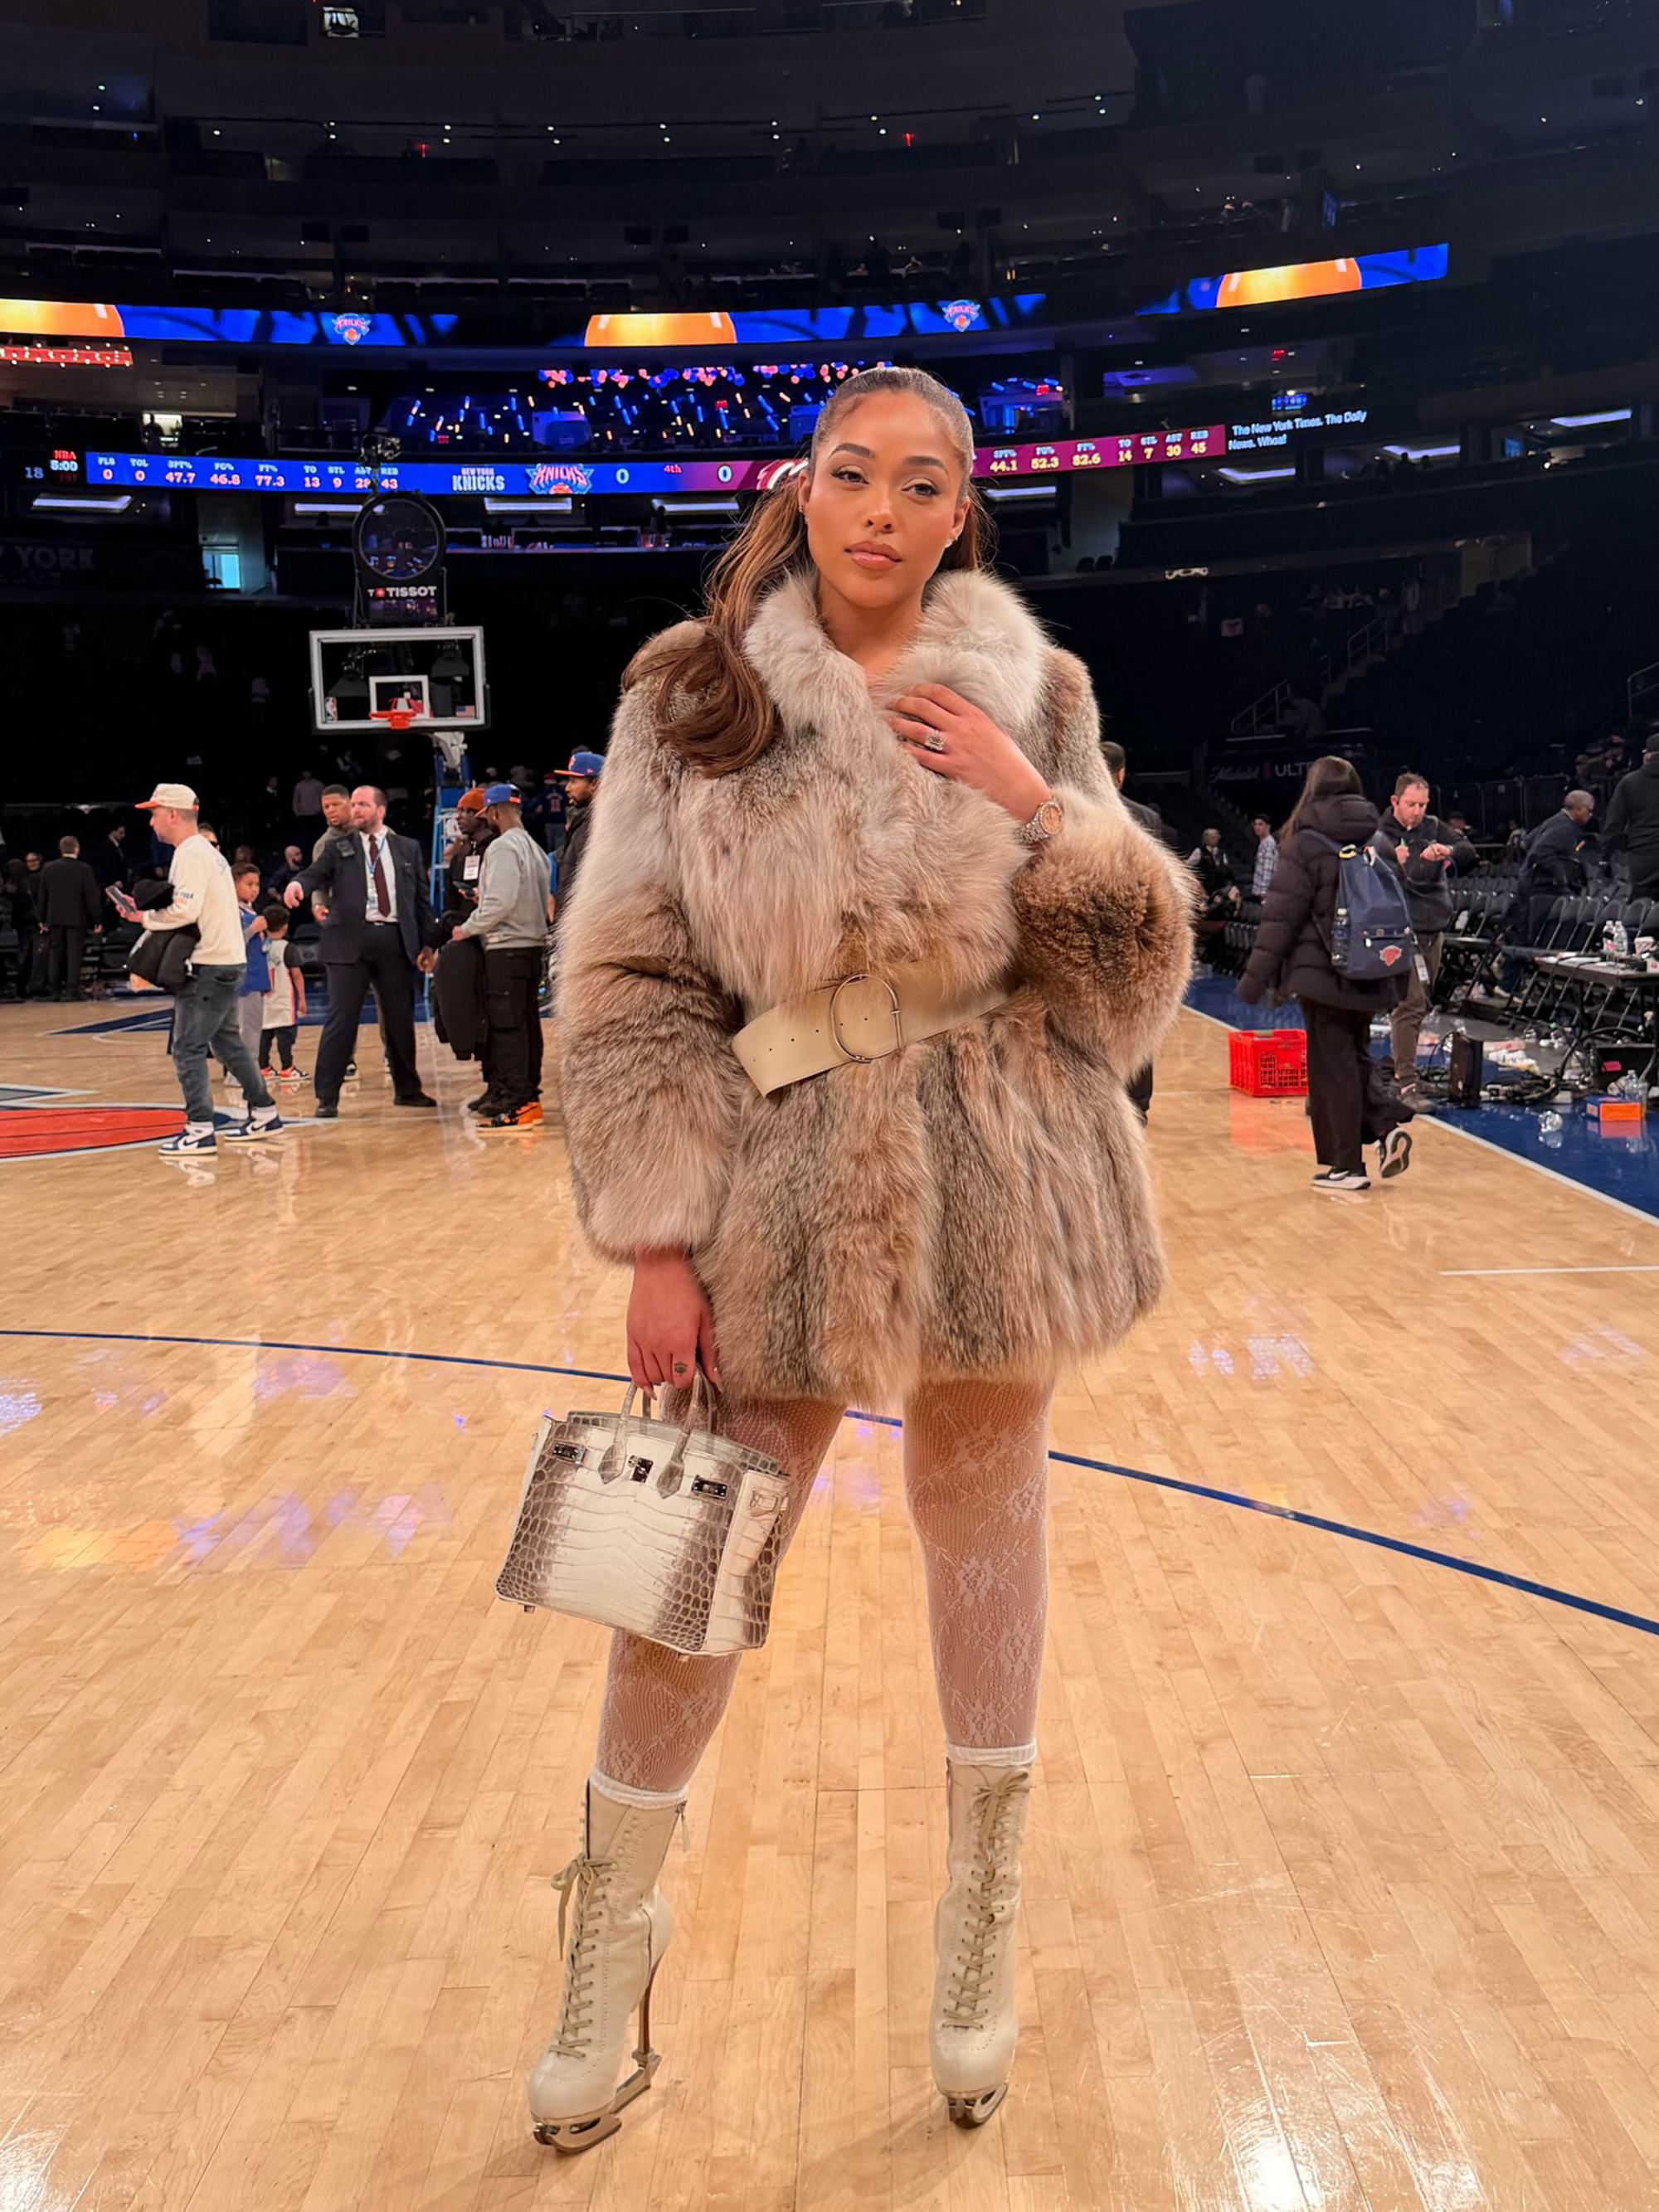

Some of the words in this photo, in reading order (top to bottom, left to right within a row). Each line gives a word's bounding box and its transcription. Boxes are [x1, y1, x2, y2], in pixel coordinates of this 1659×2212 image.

[1232, 425, 1250, 436] The
[1251, 424, 1272, 434] New
[1272, 420, 1293, 431] York
[1294, 416, 1324, 429] Times.
[1325, 414, 1342, 425] The
[1344, 410, 1367, 422] Daily
[1118, 439, 1131, 448] TO
[1140, 435, 1158, 445] STL
[1165, 433, 1183, 443] AST
[54, 450, 76, 460] NBA
[990, 460, 1017, 472] 44.1
[1031, 457, 1059, 469] 52.3
[1073, 453, 1101, 465] 82.6
[1118, 450, 1132, 462] 14
[1144, 448, 1154, 459] 7
[1166, 445, 1181, 457] 30
[1190, 442, 1206, 455] 45
[25, 466, 44, 479] 18
[130, 459, 148, 468] TOL
[304, 465, 317, 474] TO
[328, 466, 345, 474] STL
[381, 467, 399, 475] REB
[461, 467, 476, 475] NEW
[664, 464, 682, 474] 4th
[718, 464, 732, 482] 0
[103, 469, 113, 480] 0
[135, 470, 145, 481] 0
[165, 472, 196, 484] 47.7
[210, 474, 241, 486] 46.8
[255, 474, 285, 487] 77.3
[304, 477, 320, 488] 13
[333, 478, 342, 488] 9
[381, 479, 398, 489] 43
[452, 475, 505, 491] KNICKS
[533, 464, 589, 487] KNICKS
[615, 469, 630, 484] 0
[14, 545, 96, 571] YORK
[386, 586, 437, 598] TISSOT
